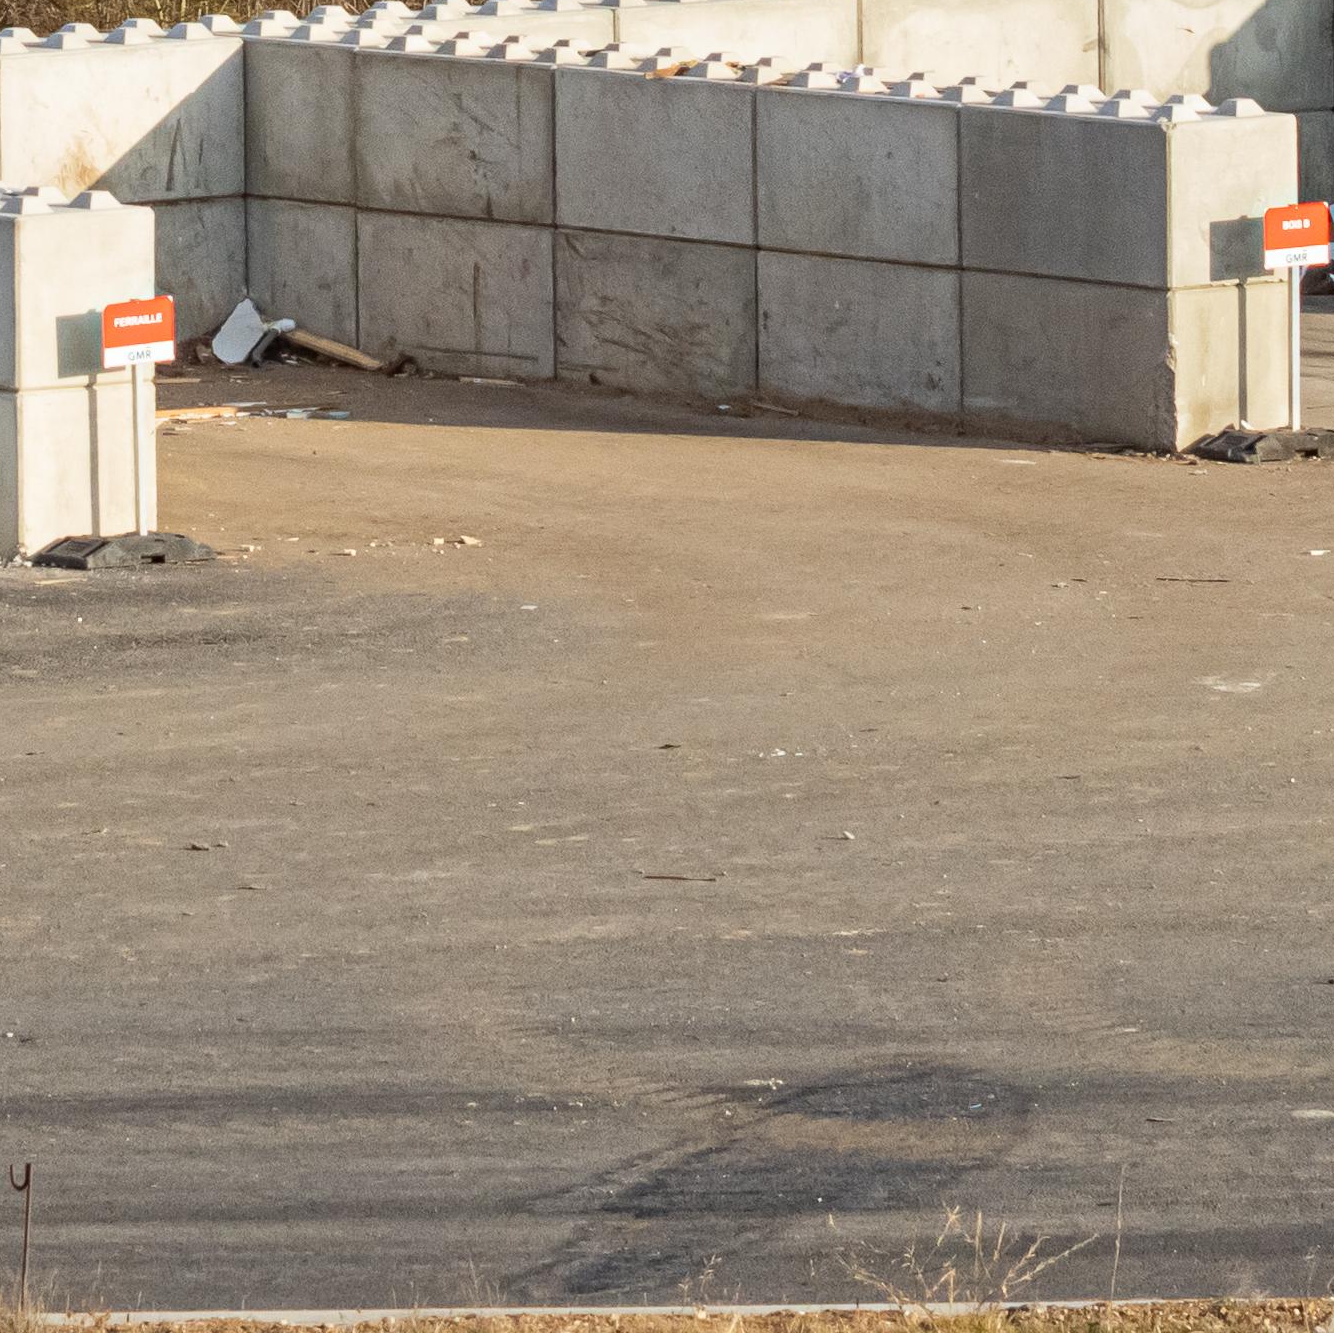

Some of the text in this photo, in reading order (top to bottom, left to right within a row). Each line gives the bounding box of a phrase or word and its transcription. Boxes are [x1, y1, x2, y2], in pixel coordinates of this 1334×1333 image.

[1282, 219, 1302, 230] BOIS
[1286, 253, 1307, 263] GMR
[114, 312, 163, 328] FERRAILLE
[128, 350, 151, 361] GMR
